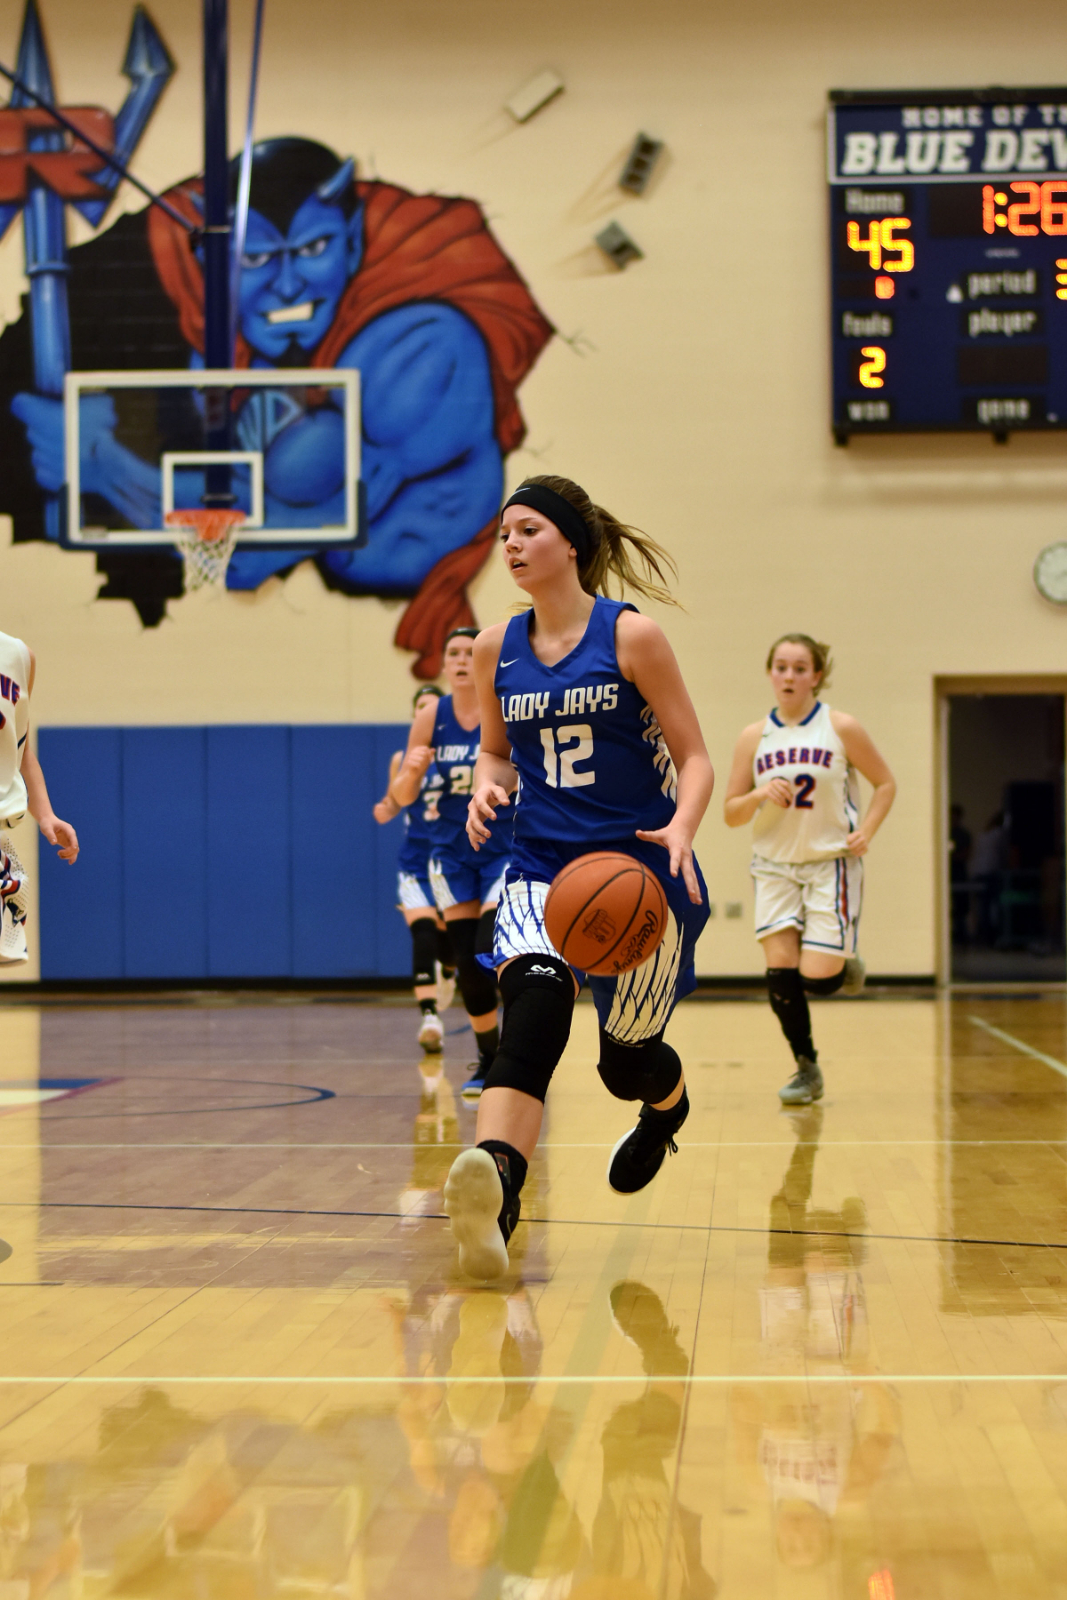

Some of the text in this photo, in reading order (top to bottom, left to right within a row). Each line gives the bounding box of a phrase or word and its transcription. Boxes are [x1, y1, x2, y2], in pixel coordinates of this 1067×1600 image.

[902, 107, 983, 127] HOME
[992, 105, 1028, 126] OF
[841, 132, 974, 174] BLUE
[983, 181, 1067, 236] 1:26
[847, 217, 915, 272] 45
[968, 270, 1036, 298] period
[968, 308, 1036, 337] player
[859, 347, 886, 388] 2
[501, 683, 619, 722] LADY JAYS
[437, 745, 469, 762] LADY
[540, 723, 595, 788] 12
